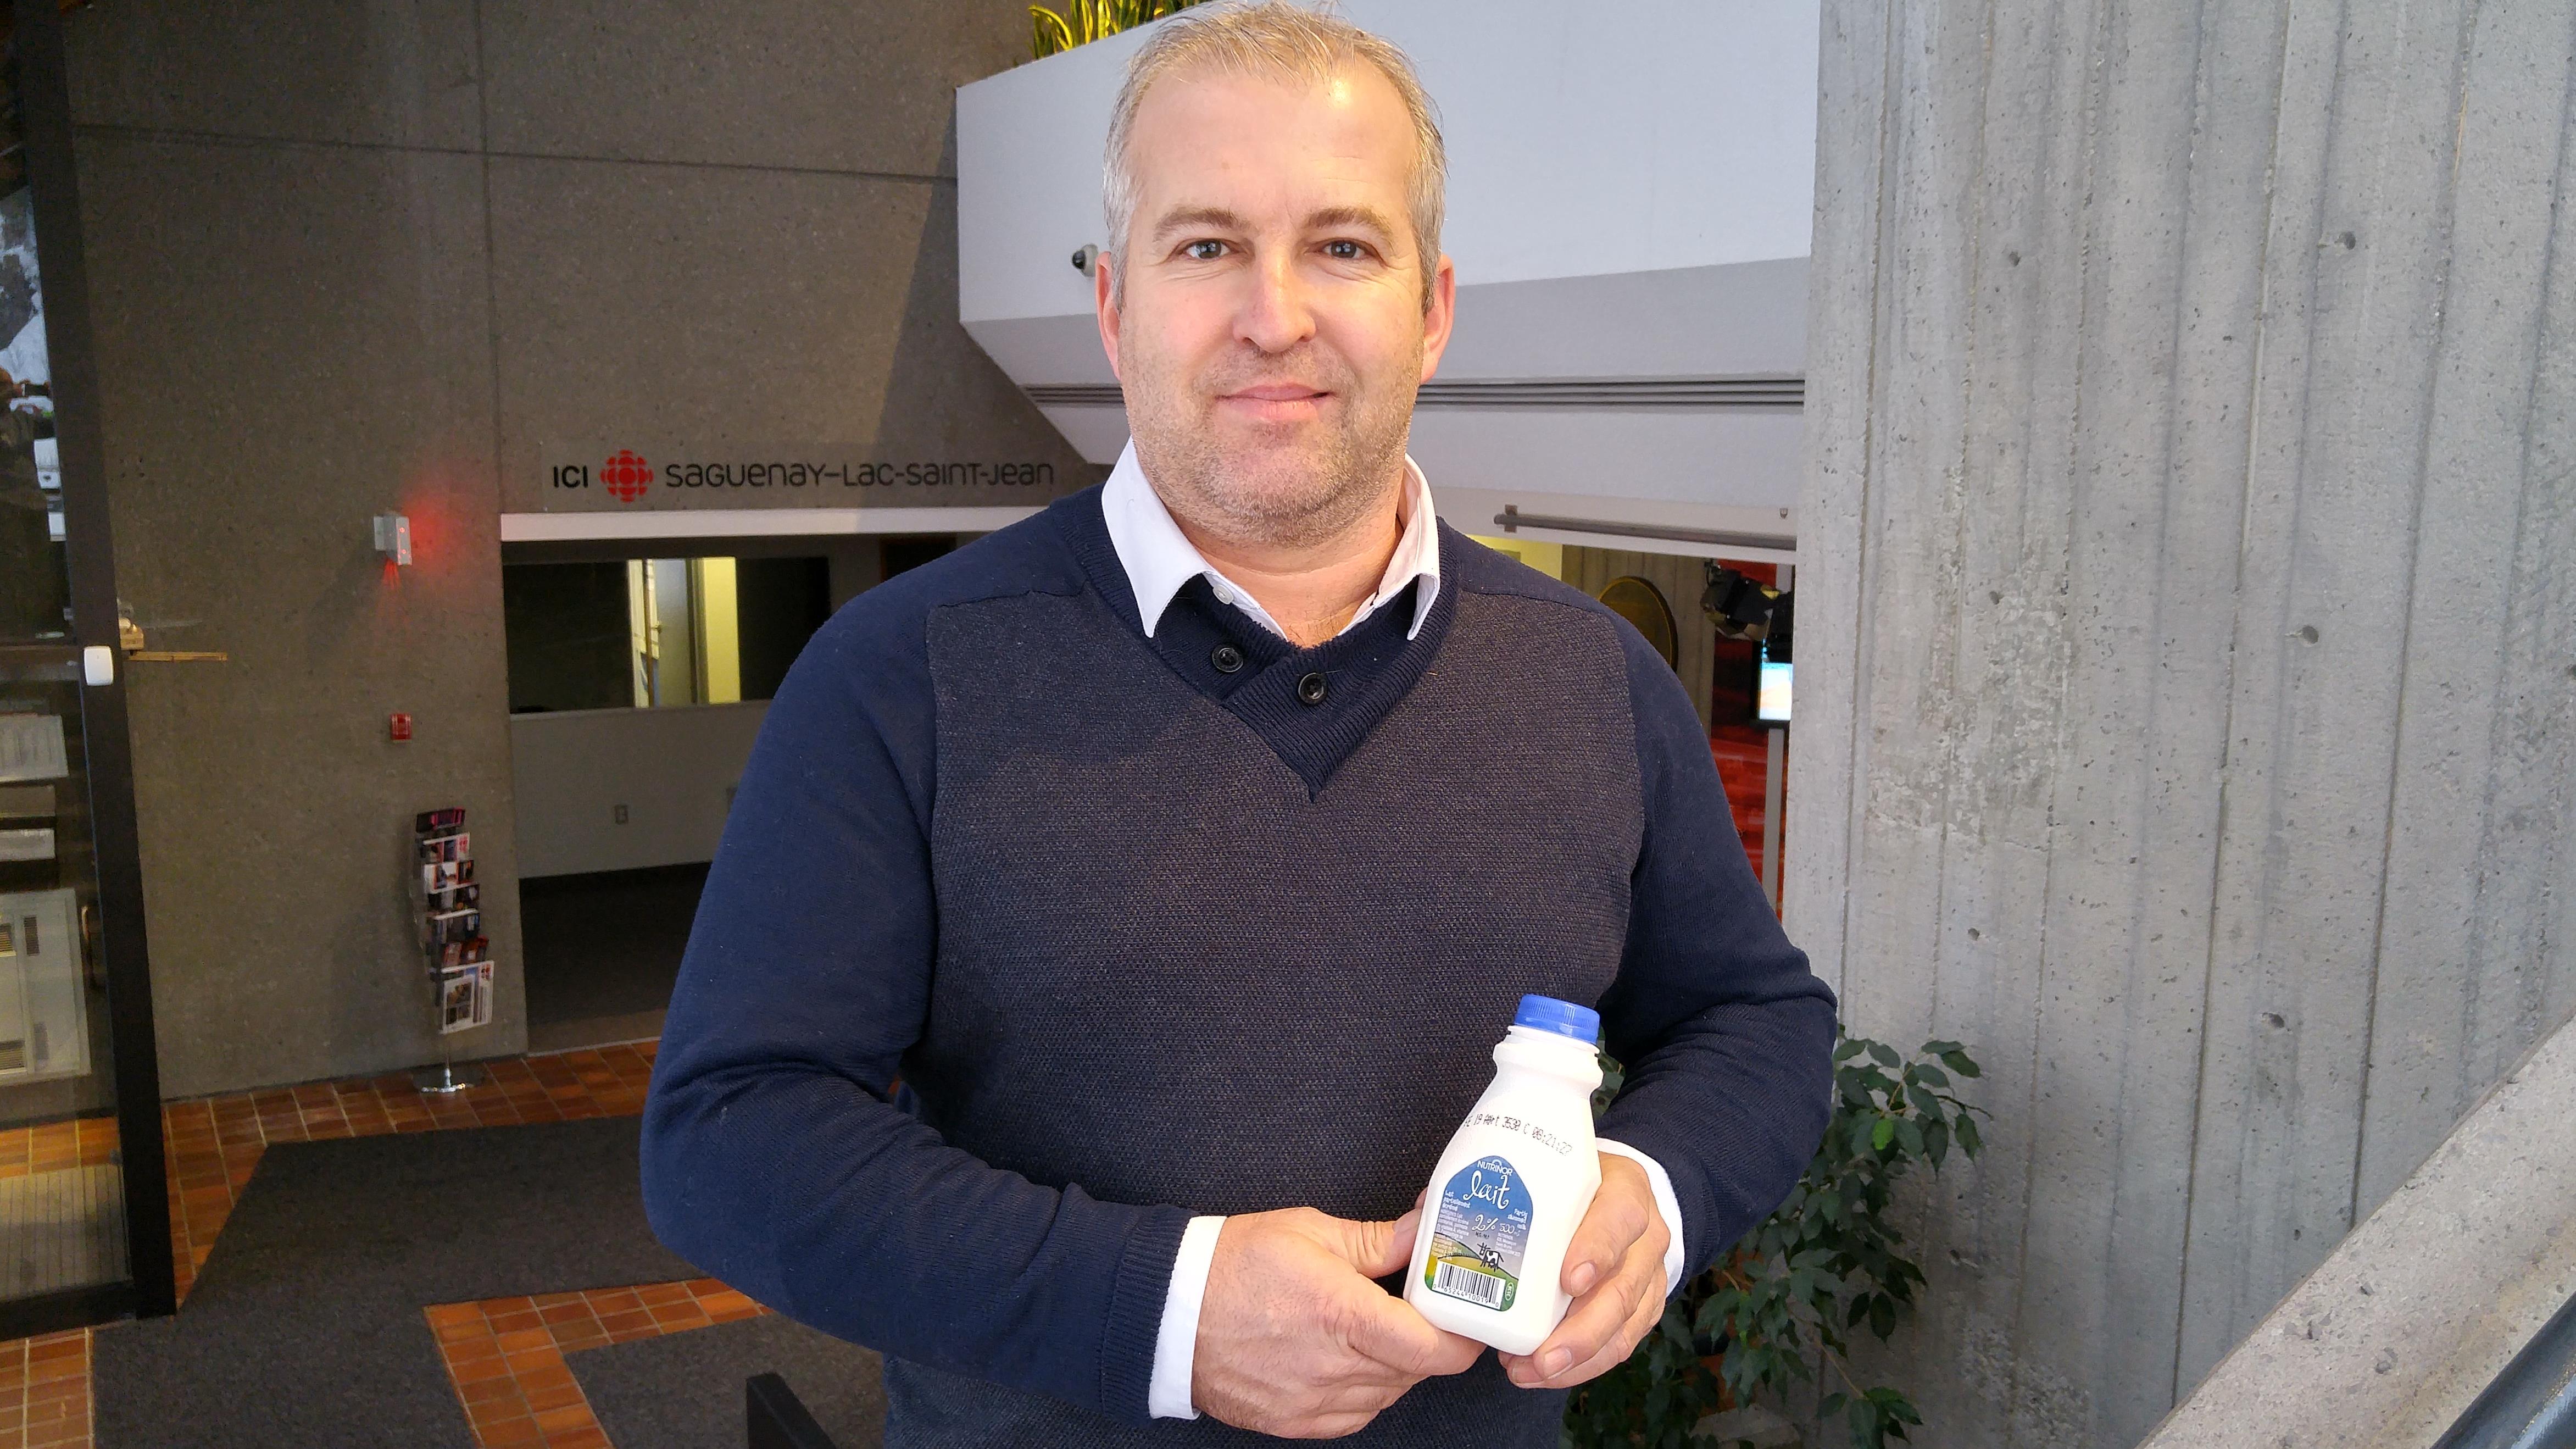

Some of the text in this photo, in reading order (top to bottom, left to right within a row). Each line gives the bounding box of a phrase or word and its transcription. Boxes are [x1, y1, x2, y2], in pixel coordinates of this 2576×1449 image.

[554, 465, 589, 488] ICI
[1477, 1160, 1513, 1176] NUTRINOR
[1462, 1170, 1510, 1209] lait
[1499, 1223, 1515, 1234] 500
[1444, 1286, 1464, 1297] 65244
[1468, 1293, 1489, 1304] 10019
